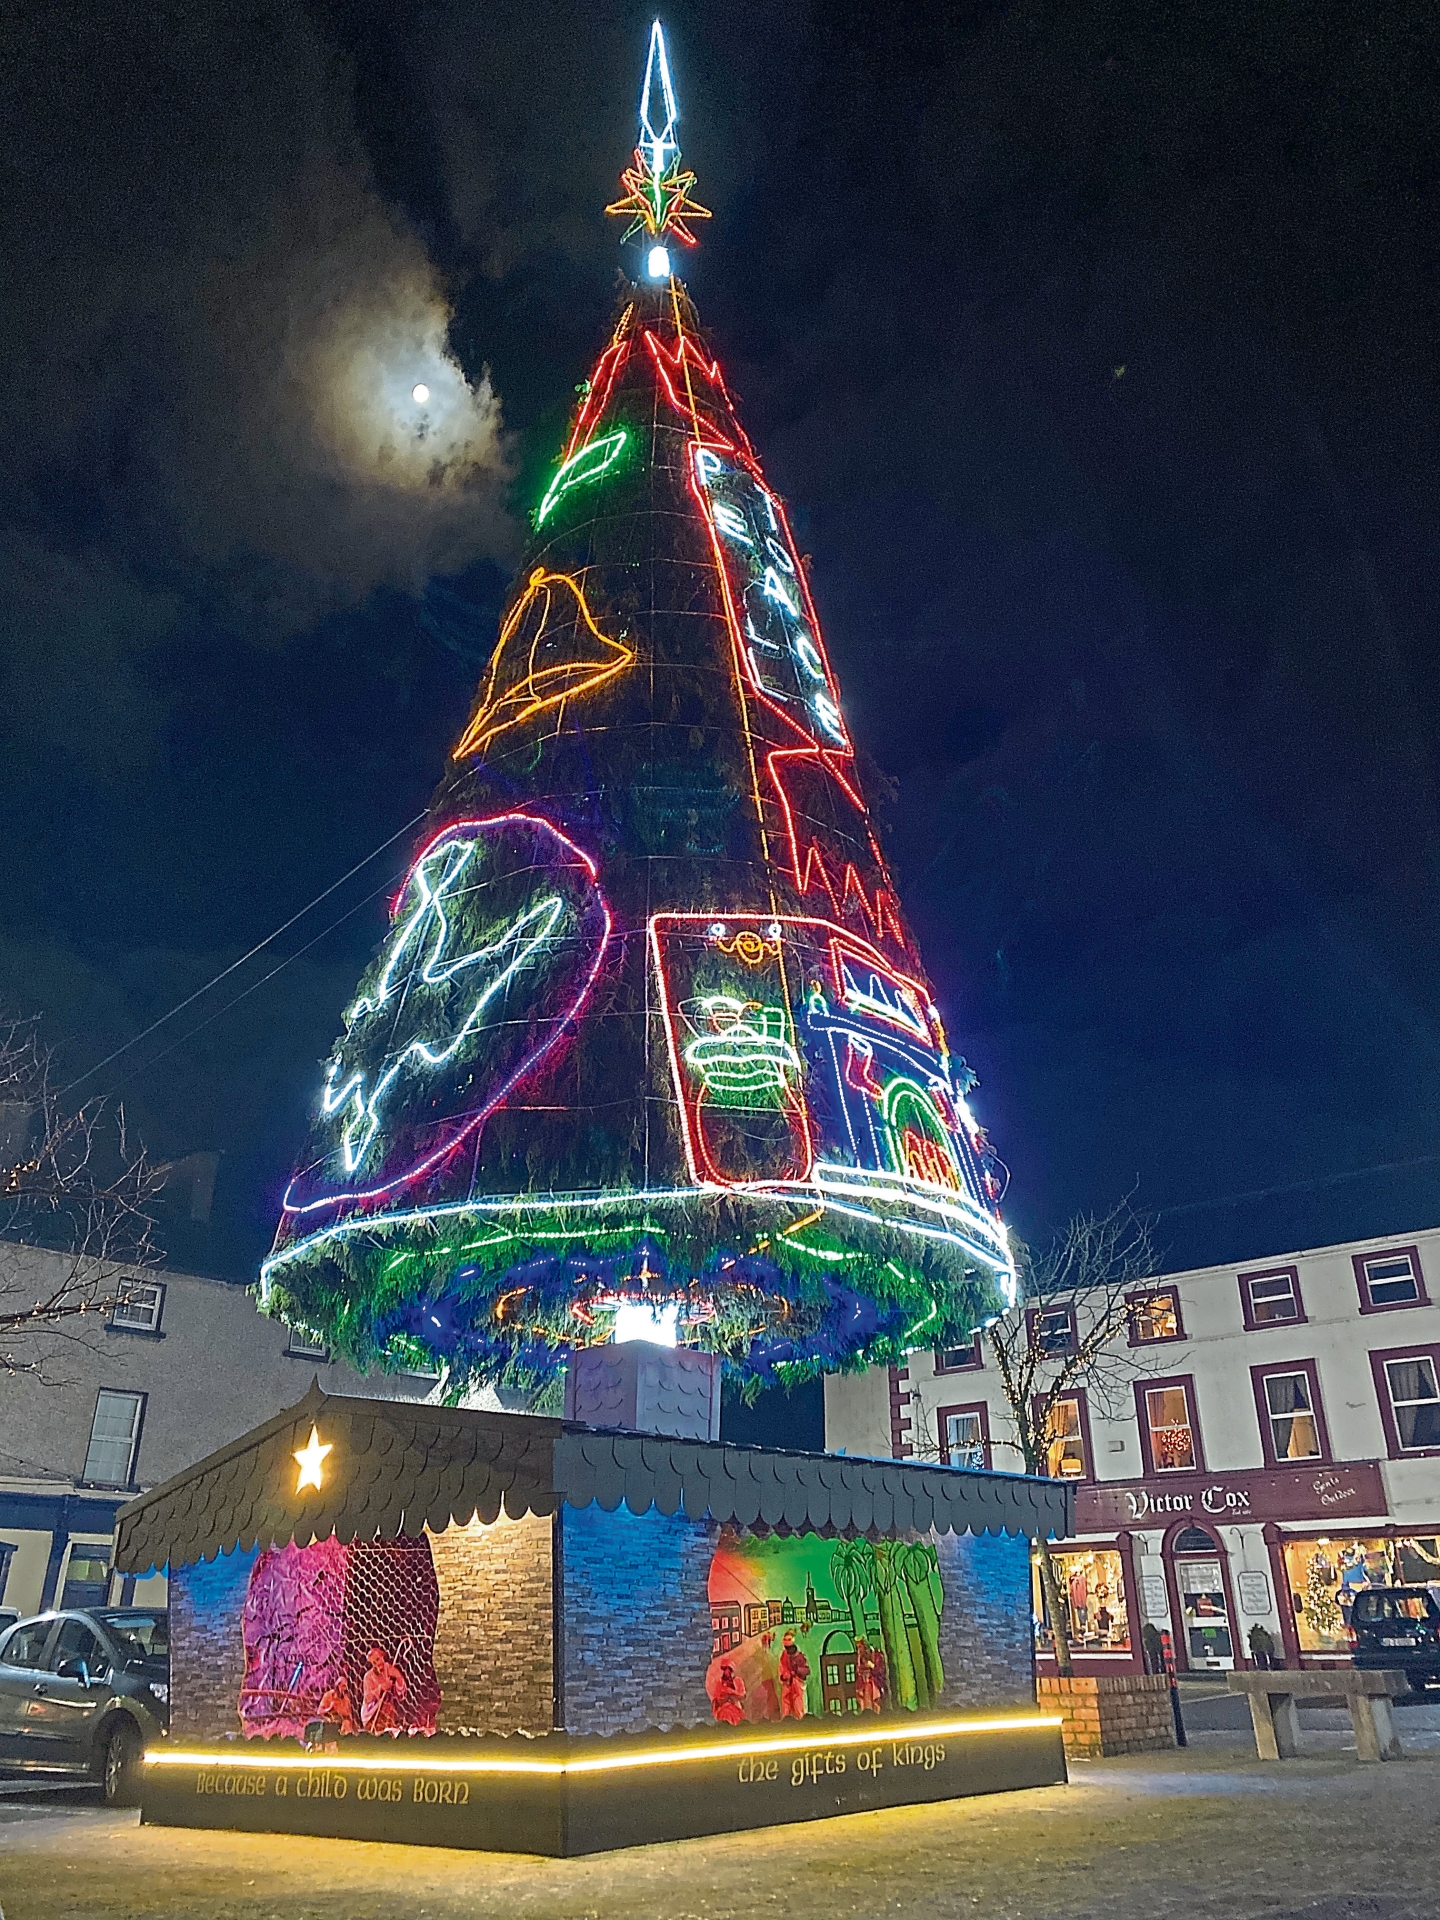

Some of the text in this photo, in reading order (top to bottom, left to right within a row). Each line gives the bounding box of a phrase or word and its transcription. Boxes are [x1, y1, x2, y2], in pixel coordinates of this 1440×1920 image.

[696, 447, 848, 744] PEACE
[1125, 1485, 1250, 1520] Victor Cox
[737, 1742, 945, 1787] the gifts of kings
[196, 1772, 266, 1796] Because
[275, 1774, 288, 1797] a
[296, 1769, 348, 1799] child
[357, 1777, 403, 1802] was
